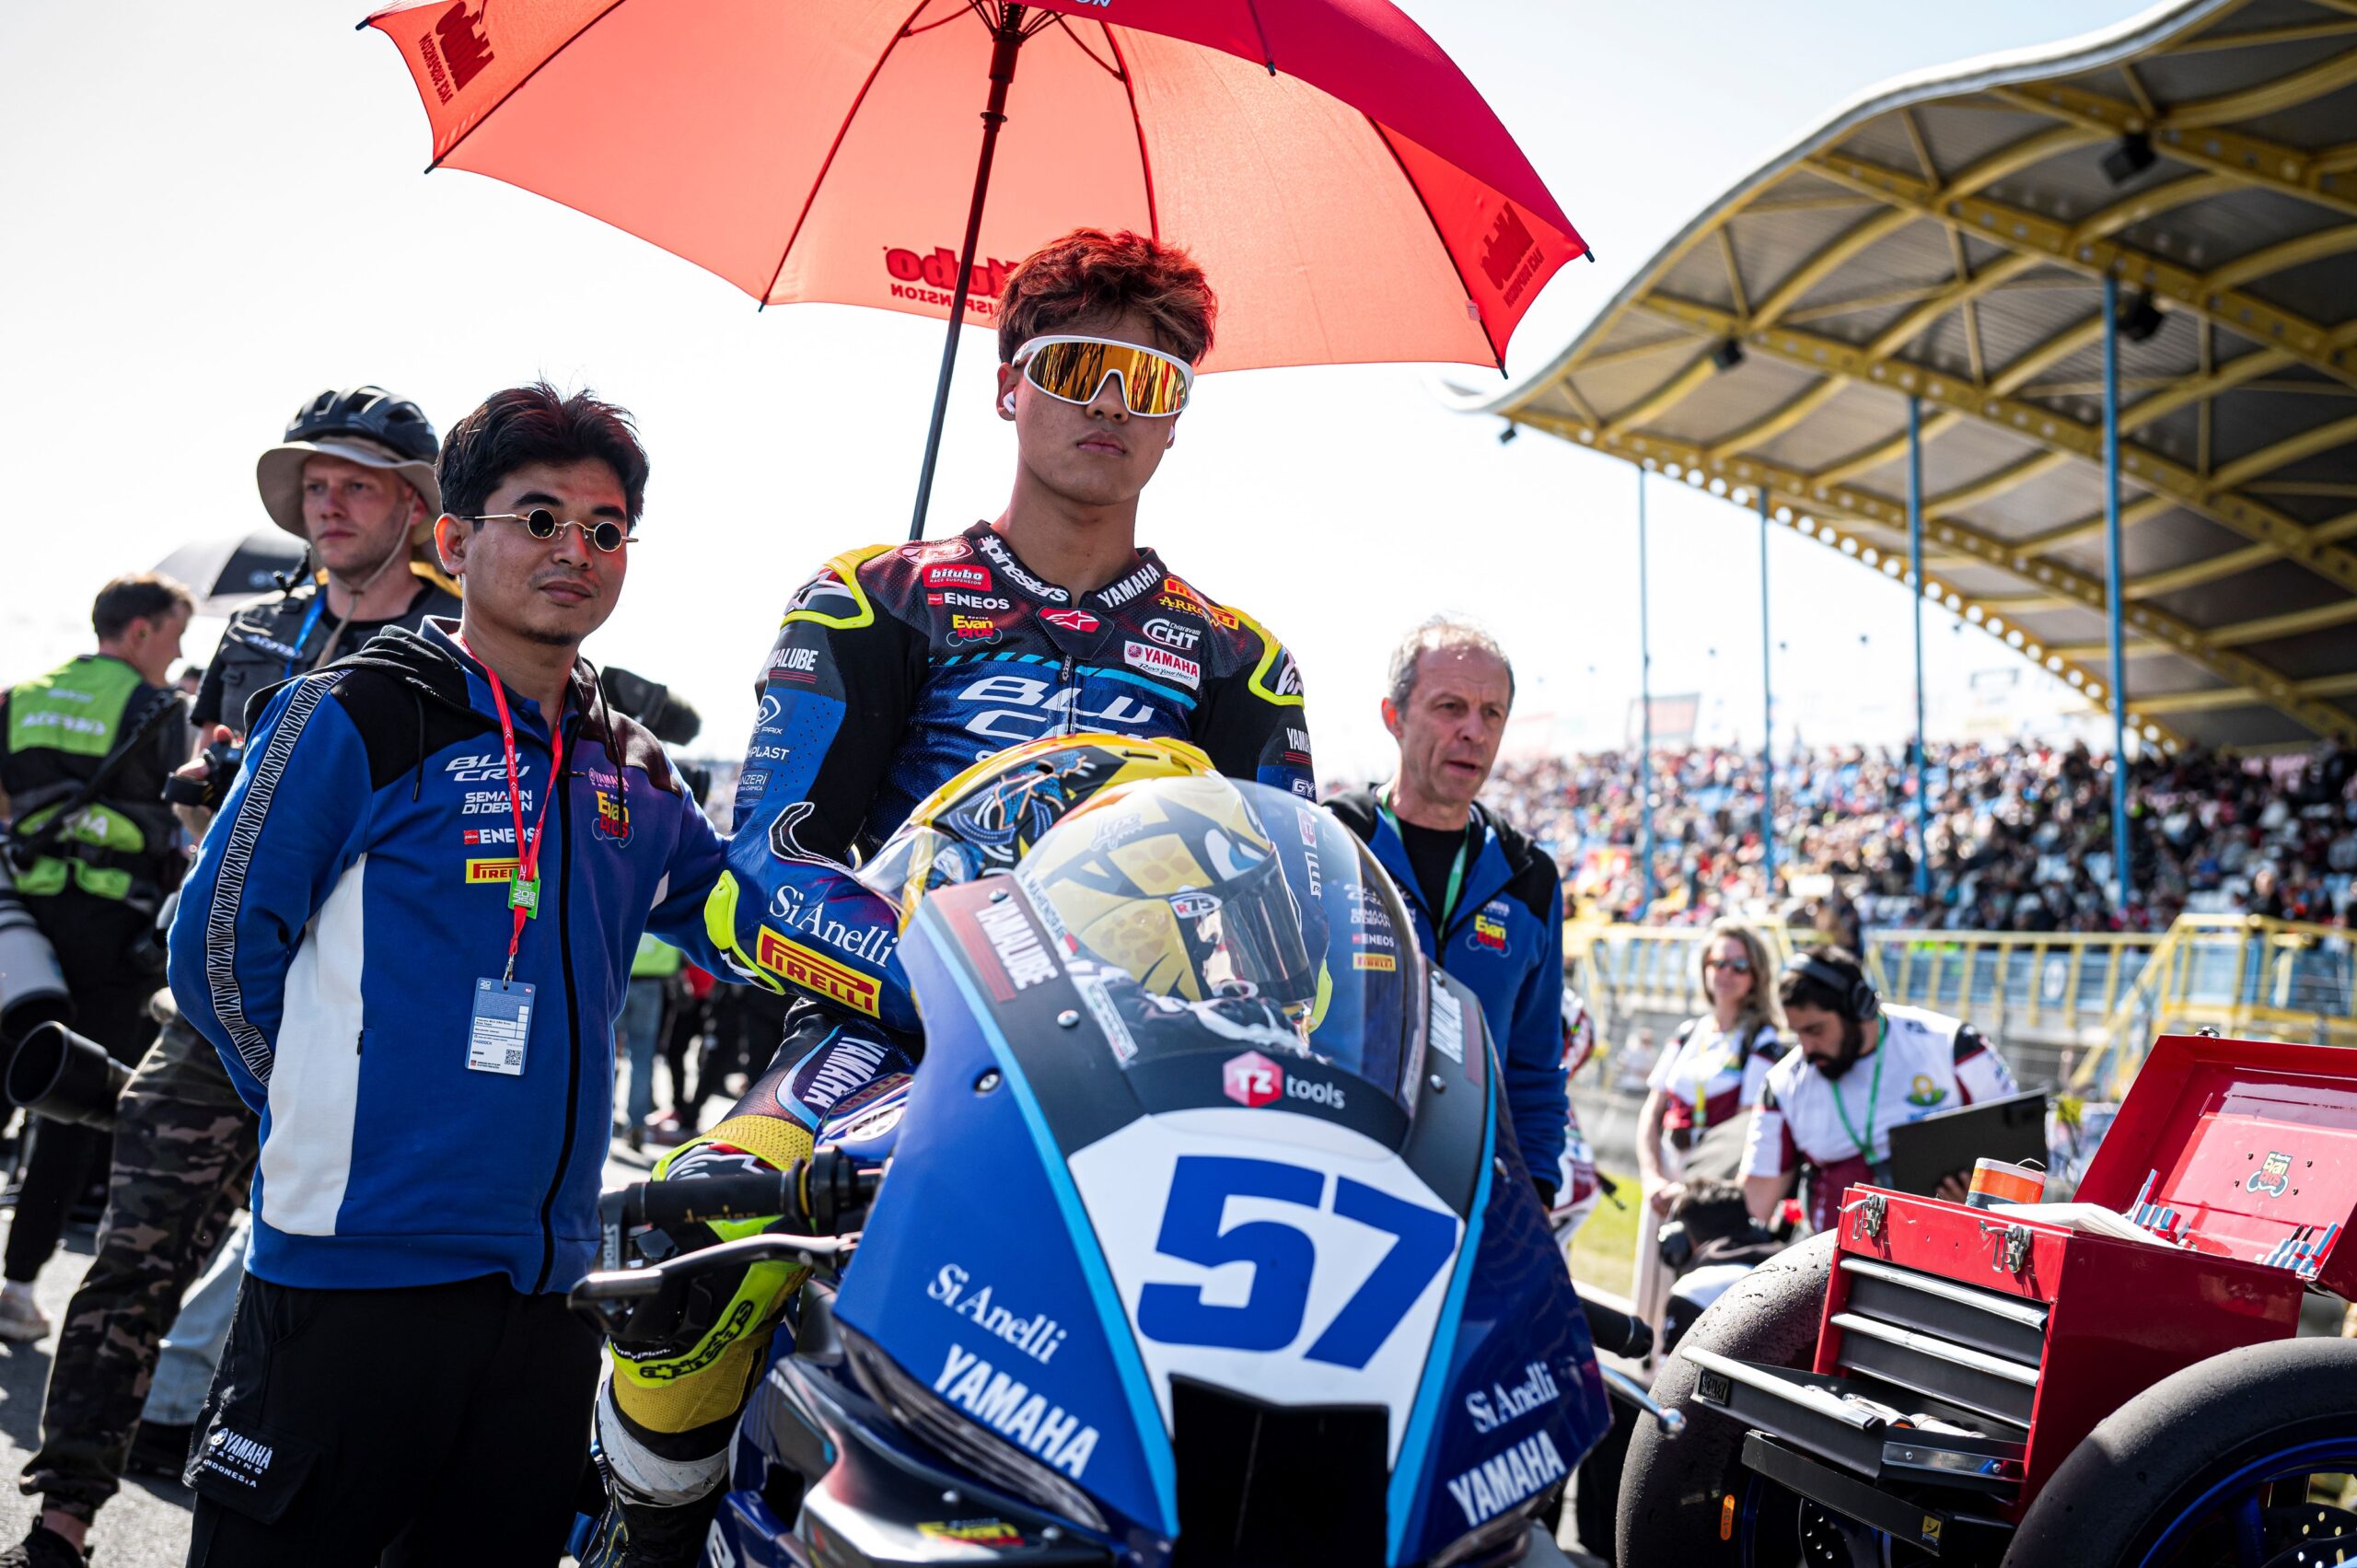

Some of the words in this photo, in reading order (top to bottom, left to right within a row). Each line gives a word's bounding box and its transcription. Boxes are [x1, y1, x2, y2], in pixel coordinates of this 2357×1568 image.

[931, 568, 984, 580] bitubo
[1097, 563, 1161, 609] YAMAHA
[944, 592, 1010, 610] ENEOS
[1158, 597, 1221, 628] ARROW
[952, 614, 993, 629] Evan
[1151, 625, 1199, 649] CHT
[766, 647, 819, 671] MALUBE
[1138, 662, 1161, 672] Revs
[1160, 668, 1176, 677] Your
[1176, 672, 1193, 681] Heart
[1144, 647, 1198, 678] YAMAHA
[958, 676, 1155, 724] BLU
[761, 726, 784, 735] PRIX
[746, 746, 790, 761] PLAST
[595, 772, 630, 789] YAMAA
[461, 804, 479, 815] DI
[596, 790, 630, 823] Evan
[1475, 914, 1507, 940] Evan
[975, 895, 1059, 991] YAMALUBE
[761, 933, 876, 1012] PIRELLI
[803, 1037, 889, 1109] YAMAHA
[1235, 1067, 1272, 1095] TZ
[1286, 1074, 1345, 1109] tools
[603, 1224, 620, 1272] SPIDE
[1137, 1154, 1457, 1371] 57
[932, 1343, 1100, 1480] YAMAHA
[208, 1446, 262, 1475] RACING
[224, 1431, 273, 1469] YAMAHA
[1446, 1429, 1567, 1528] YAMAHA
